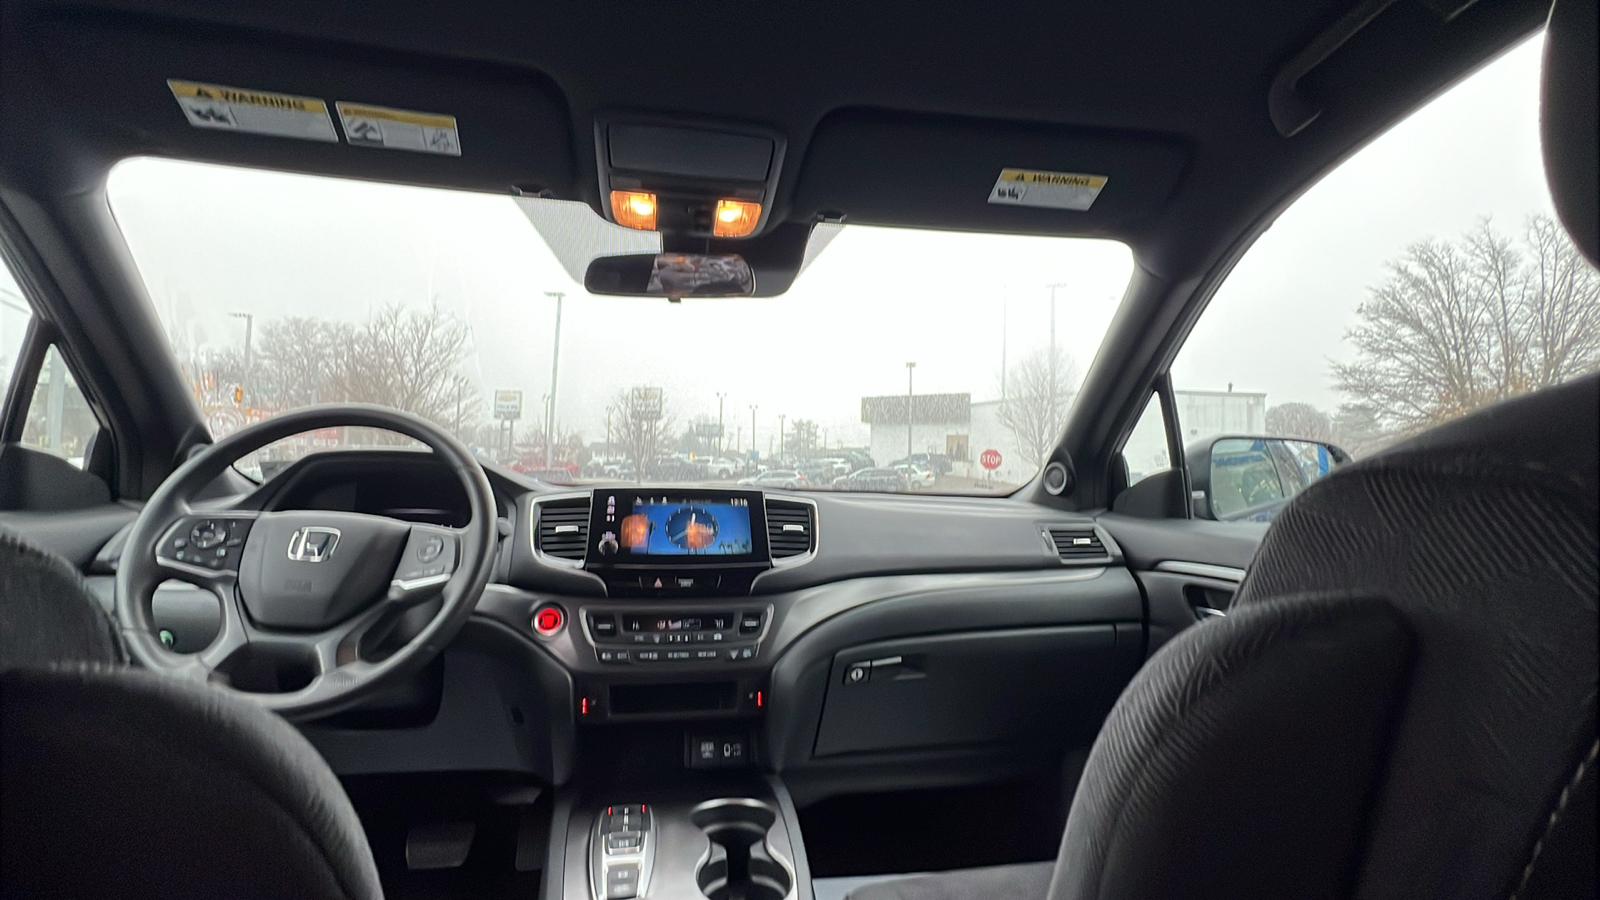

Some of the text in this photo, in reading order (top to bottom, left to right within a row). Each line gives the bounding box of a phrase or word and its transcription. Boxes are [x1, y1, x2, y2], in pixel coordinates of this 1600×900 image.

[220, 90, 307, 109] WARNING
[1032, 172, 1090, 186] WARNING
[980, 454, 1001, 465] STOP
